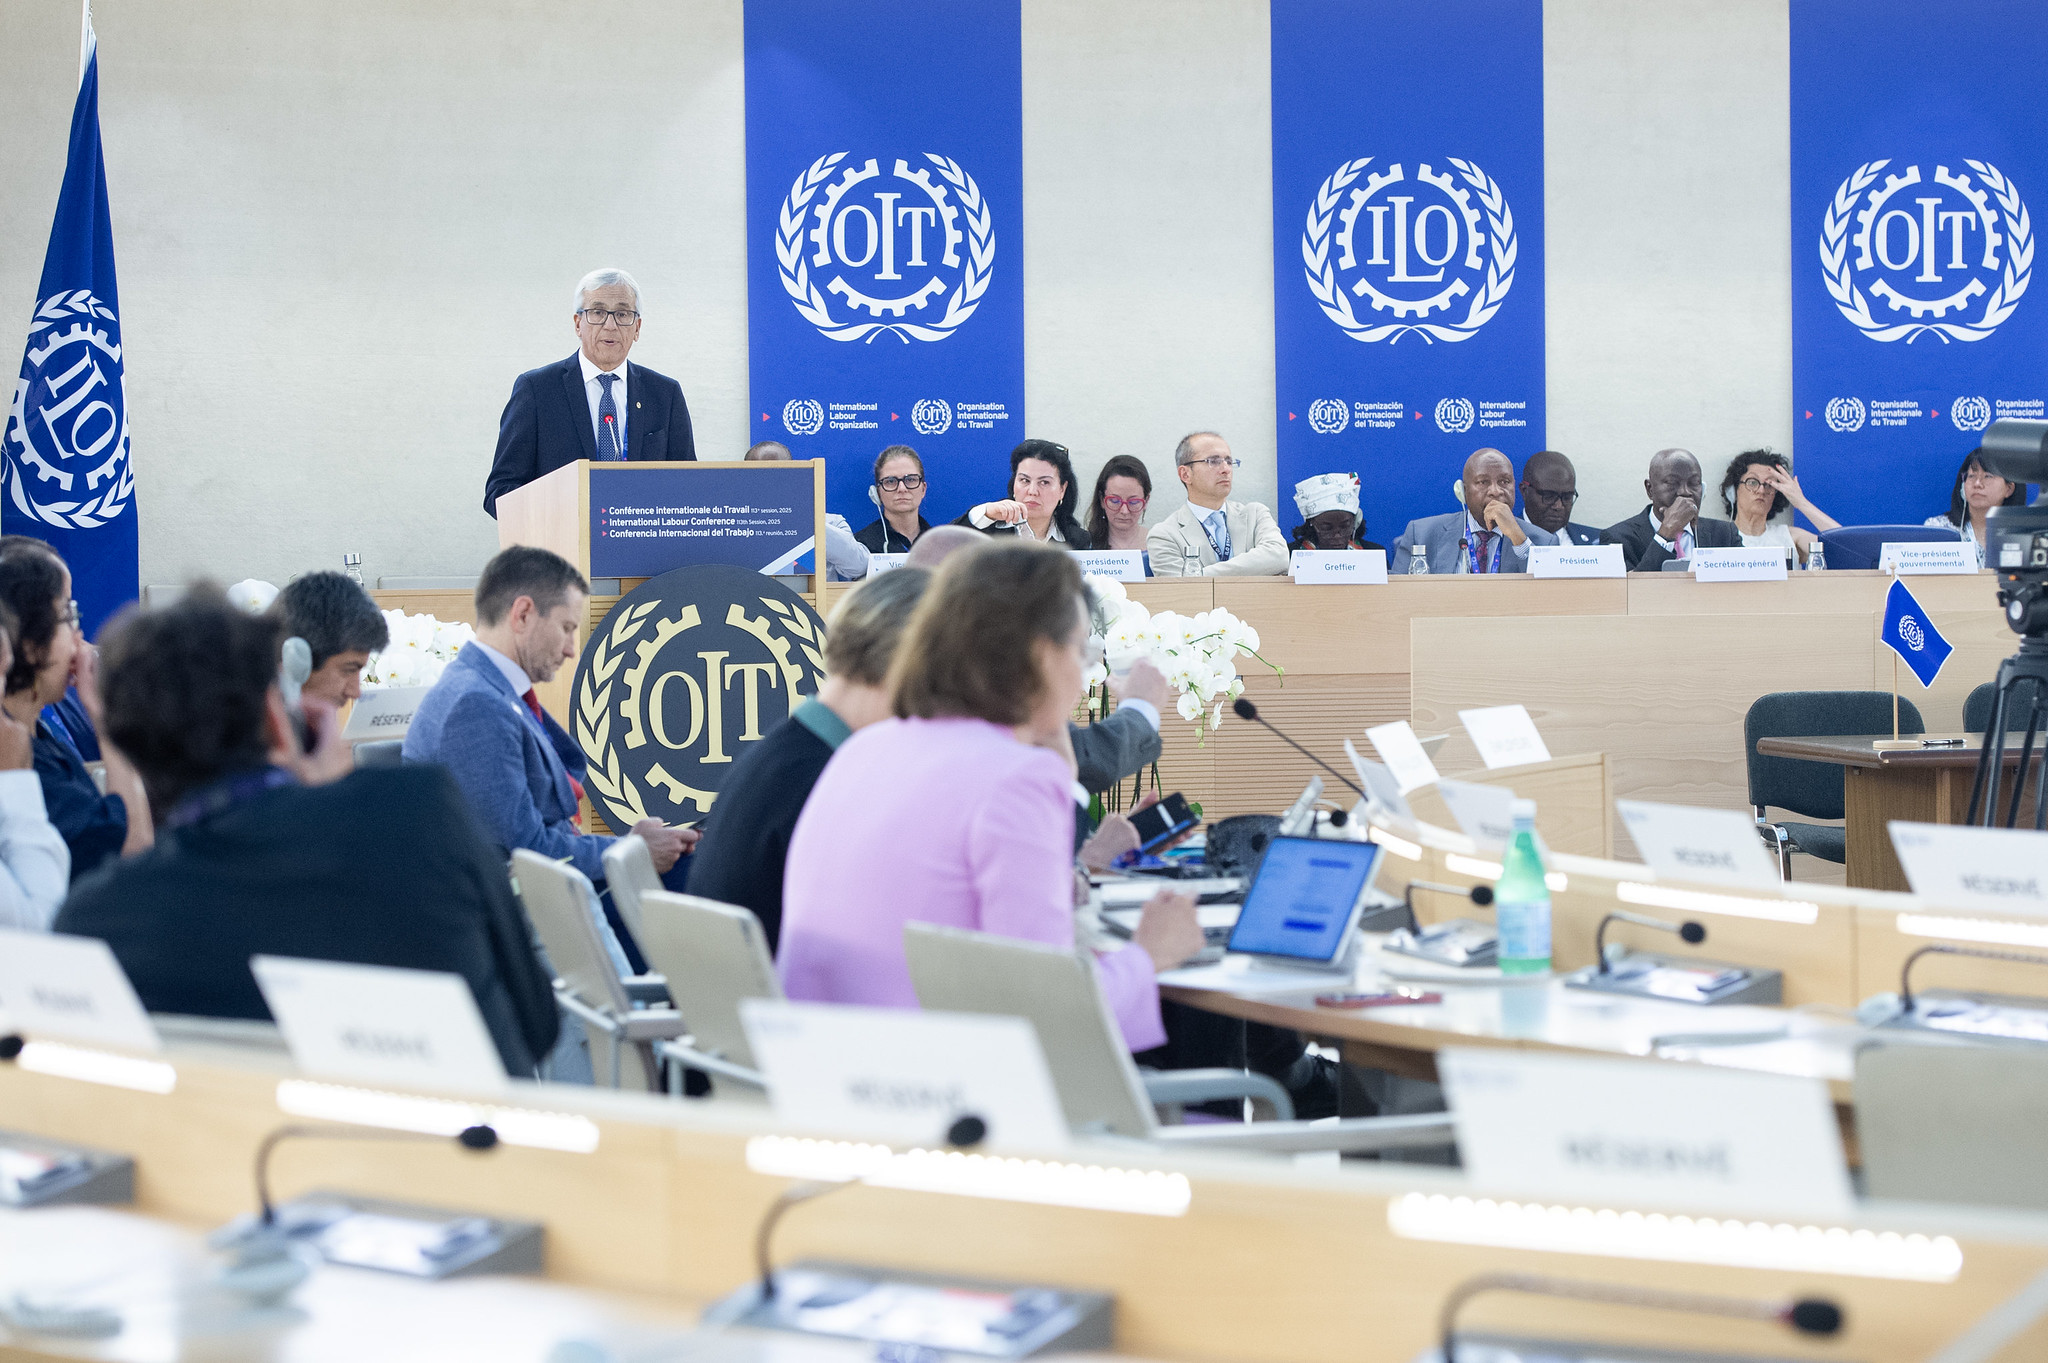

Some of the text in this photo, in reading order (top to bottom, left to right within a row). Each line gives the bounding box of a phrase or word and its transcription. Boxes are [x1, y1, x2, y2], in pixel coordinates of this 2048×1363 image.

[833, 192, 936, 280] OIT
[1366, 196, 1459, 283] ILO
[1875, 198, 1976, 282] OIT
[38, 345, 117, 460] ILO
[829, 402, 878, 411] International
[957, 402, 1005, 412] Organisation
[1354, 401, 1404, 411] Organización
[1479, 401, 1526, 410] International
[1870, 400, 1919, 410] Organisation
[1995, 399, 2045, 410] Organización
[829, 412, 857, 420] Labour
[957, 411, 1009, 420] internationale
[1354, 411, 1404, 419] Internacional
[1479, 410, 1506, 419] Labour
[1870, 409, 1923, 418] internationale
[1995, 408, 2044, 417] Internacional
[829, 421, 879, 431] Organization
[957, 421, 994, 429] du Travail
[1354, 420, 1396, 430] del Trabajo
[1479, 419, 1527, 429] Organization
[1870, 418, 1907, 427] du Travail
[609, 506, 655, 515] Conférence
[655, 505, 711, 515] internationale
[712, 505, 723, 514] du
[723, 505, 750, 514] Travail
[609, 517, 660, 526] International
[661, 517, 690, 526] Labour
[690, 516, 736, 526] Conference
[609, 529, 658, 538] Conferencia
[658, 528, 710, 537] Internacional
[711, 528, 724, 537] del
[724, 528, 755, 538] Trabajo
[1900, 550, 1961, 559] Vice-président
[1077, 558, 1130, 566] e-présidente
[1559, 557, 1599, 565] Président
[1703, 560, 1778, 569] Secrétaire général
[1899, 561, 1965, 569] gouvernemental
[1324, 563, 1356, 571] Greffier
[648, 651, 777, 764] OIT
